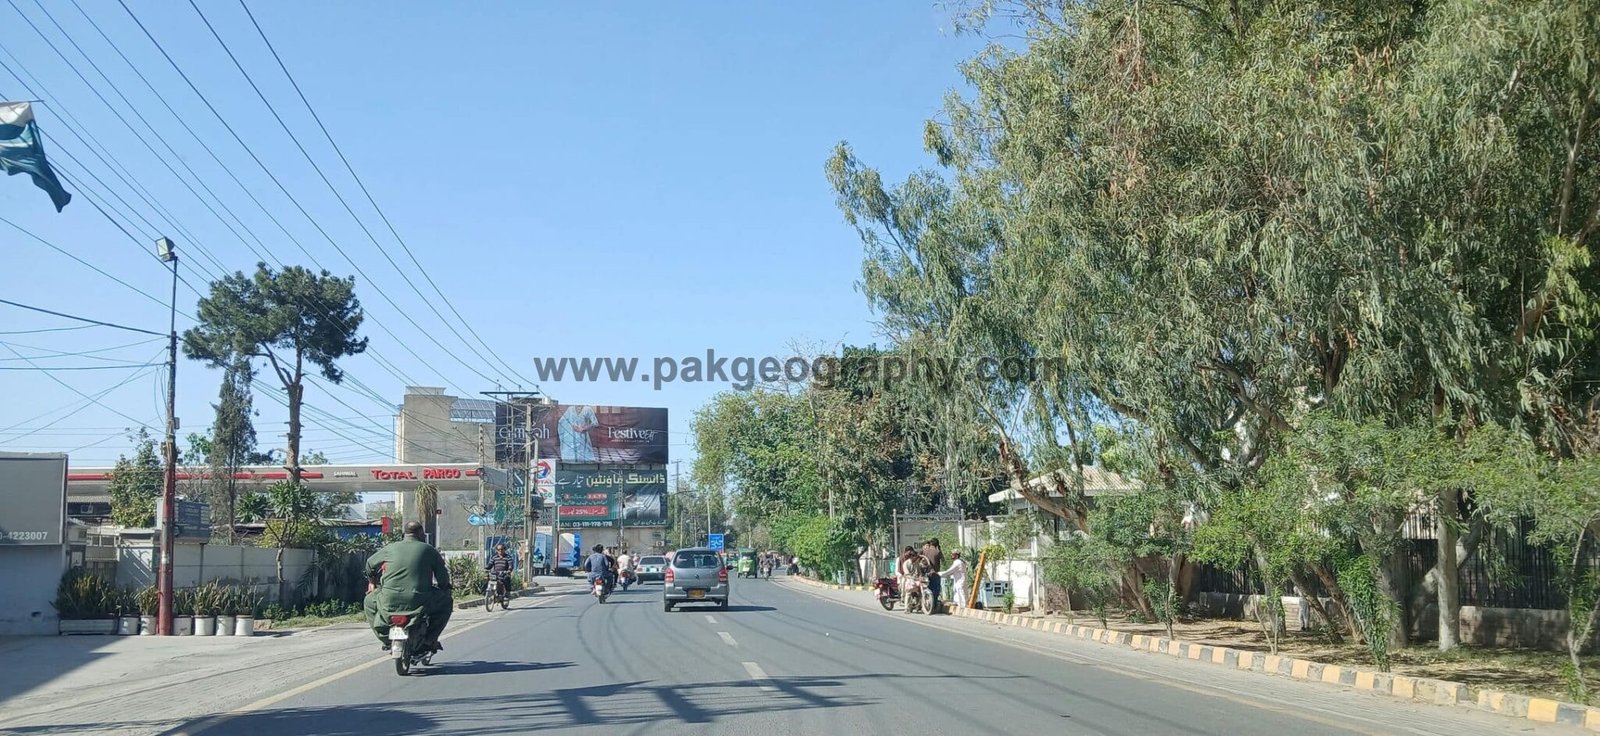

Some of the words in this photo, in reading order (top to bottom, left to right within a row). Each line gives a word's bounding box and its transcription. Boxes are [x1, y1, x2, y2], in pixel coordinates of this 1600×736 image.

[608, 427, 645, 439] Festive
[371, 470, 417, 480] TOTAL
[424, 469, 461, 479] PARCO
